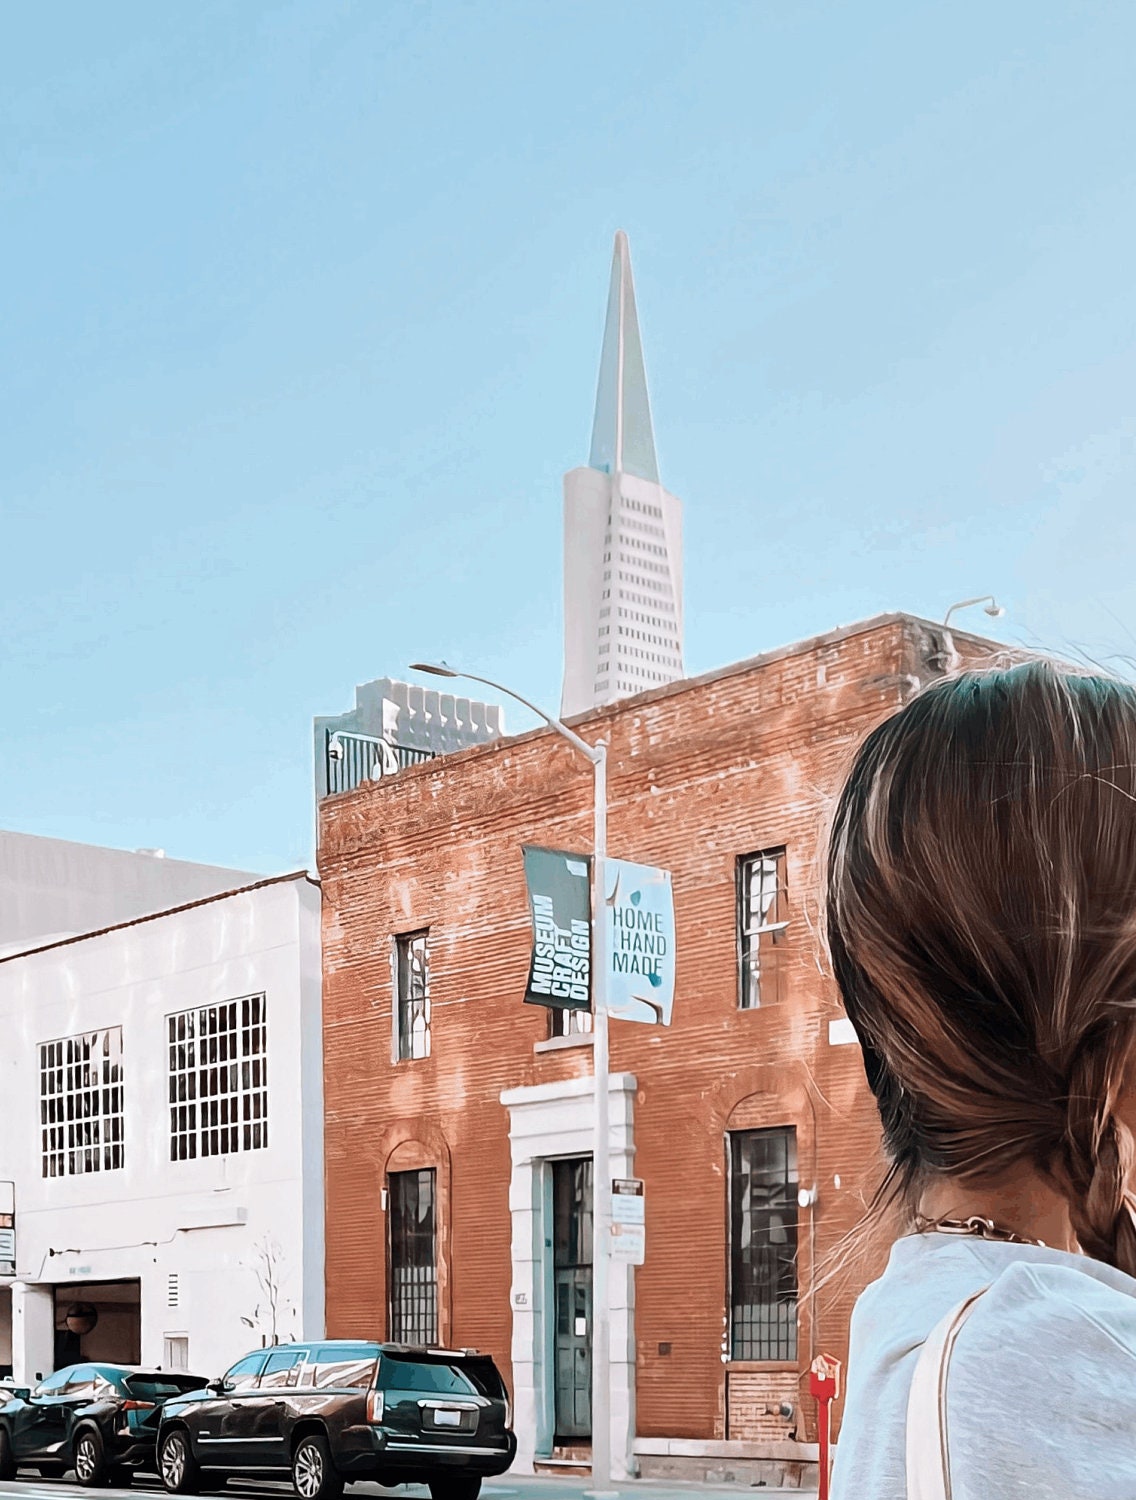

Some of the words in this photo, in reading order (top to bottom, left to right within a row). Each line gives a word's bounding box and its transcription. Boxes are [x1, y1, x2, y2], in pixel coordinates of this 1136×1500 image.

[531, 894, 555, 995] MUSEUM
[613, 907, 664, 933] HOME
[621, 931, 667, 956] HAND
[551, 924, 573, 998] CRAFT
[570, 919, 590, 1001] DESIGN
[613, 952, 663, 977] MADE
